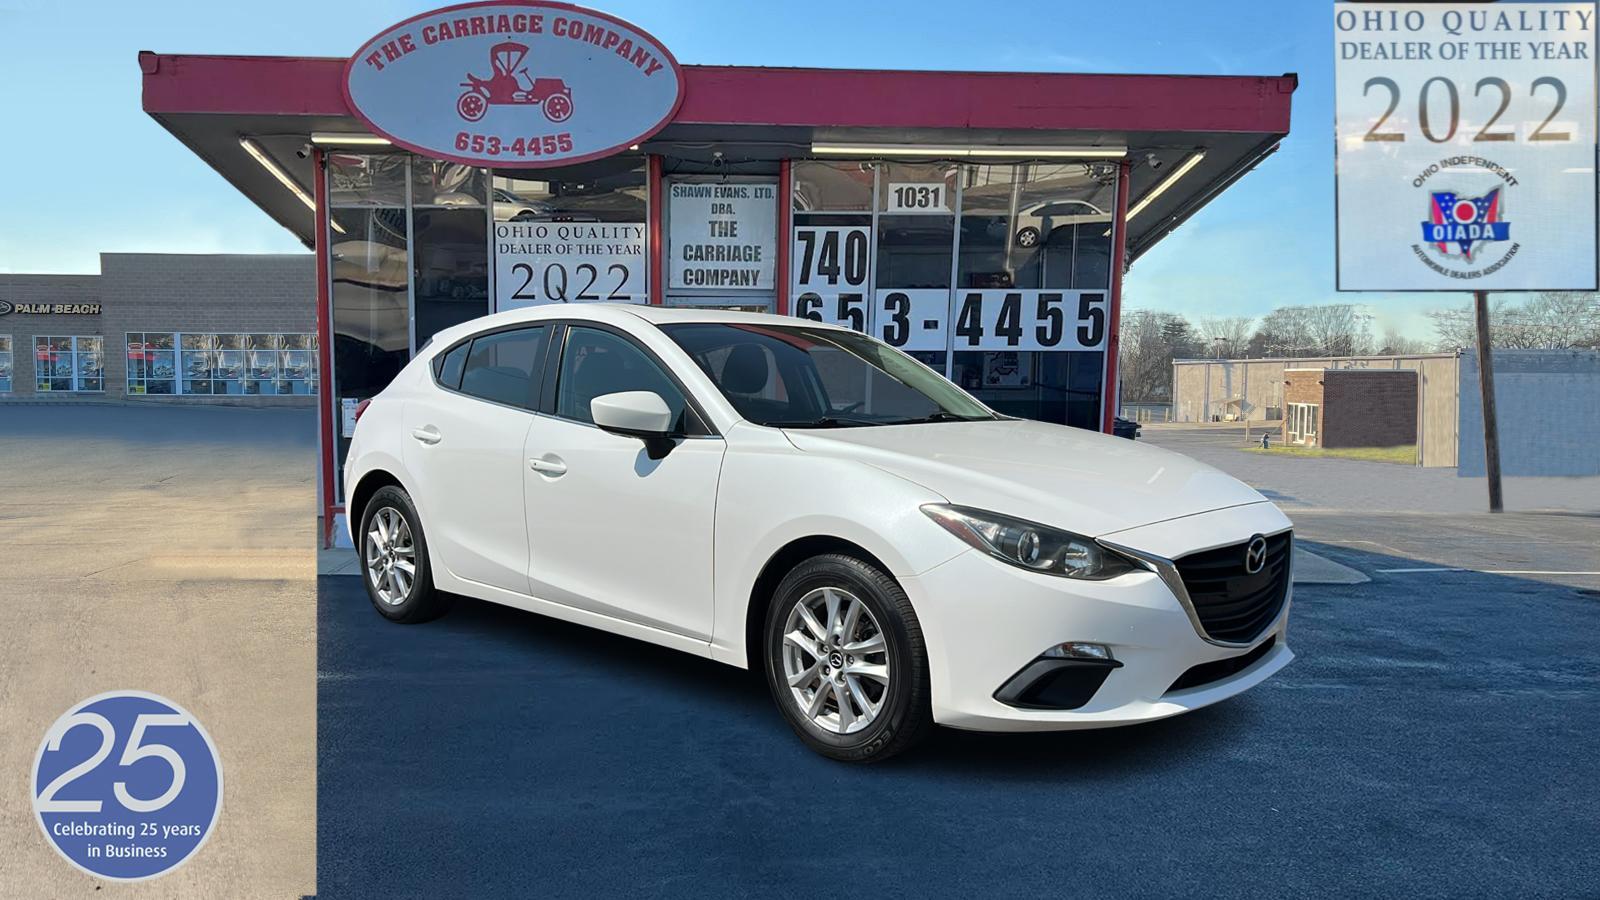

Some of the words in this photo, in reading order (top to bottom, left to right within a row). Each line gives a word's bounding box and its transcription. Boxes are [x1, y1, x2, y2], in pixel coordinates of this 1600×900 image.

[1336, 10, 1425, 31] OHIO
[1442, 10, 1593, 36] QUALITY
[366, 33, 417, 71] THE
[422, 14, 544, 46] CARRIAGE
[552, 17, 664, 77] COMPANY
[1340, 42, 1433, 60] DEALER
[1438, 42, 1470, 60] OF
[1474, 42, 1521, 60] THE
[1528, 42, 1589, 60] YEAR
[1363, 76, 1571, 143] 2022
[455, 131, 573, 157] 653-4455
[1412, 164, 1439, 188] OHIO
[1440, 156, 1519, 187] INDEPENDENT
[673, 186, 712, 198] SHAWN
[754, 187, 774, 199] LTD.
[894, 186, 940, 208] 1031
[711, 203, 736, 215] DBA.
[497, 226, 548, 239] OHIO
[558, 226, 644, 241] QUALITY
[708, 220, 738, 238] THE
[1433, 225, 1495, 240] OIADA
[499, 244, 551, 254] DEALER
[555, 244, 573, 254] OF
[576, 244, 603, 254] THE
[607, 244, 641, 255] YEAR
[683, 244, 762, 262] CARRIAGE
[798, 230, 868, 286] 740
[683, 268, 761, 286] COMPANY
[15, 304, 50, 314] PALM
[54, 304, 100, 314] BEACH
